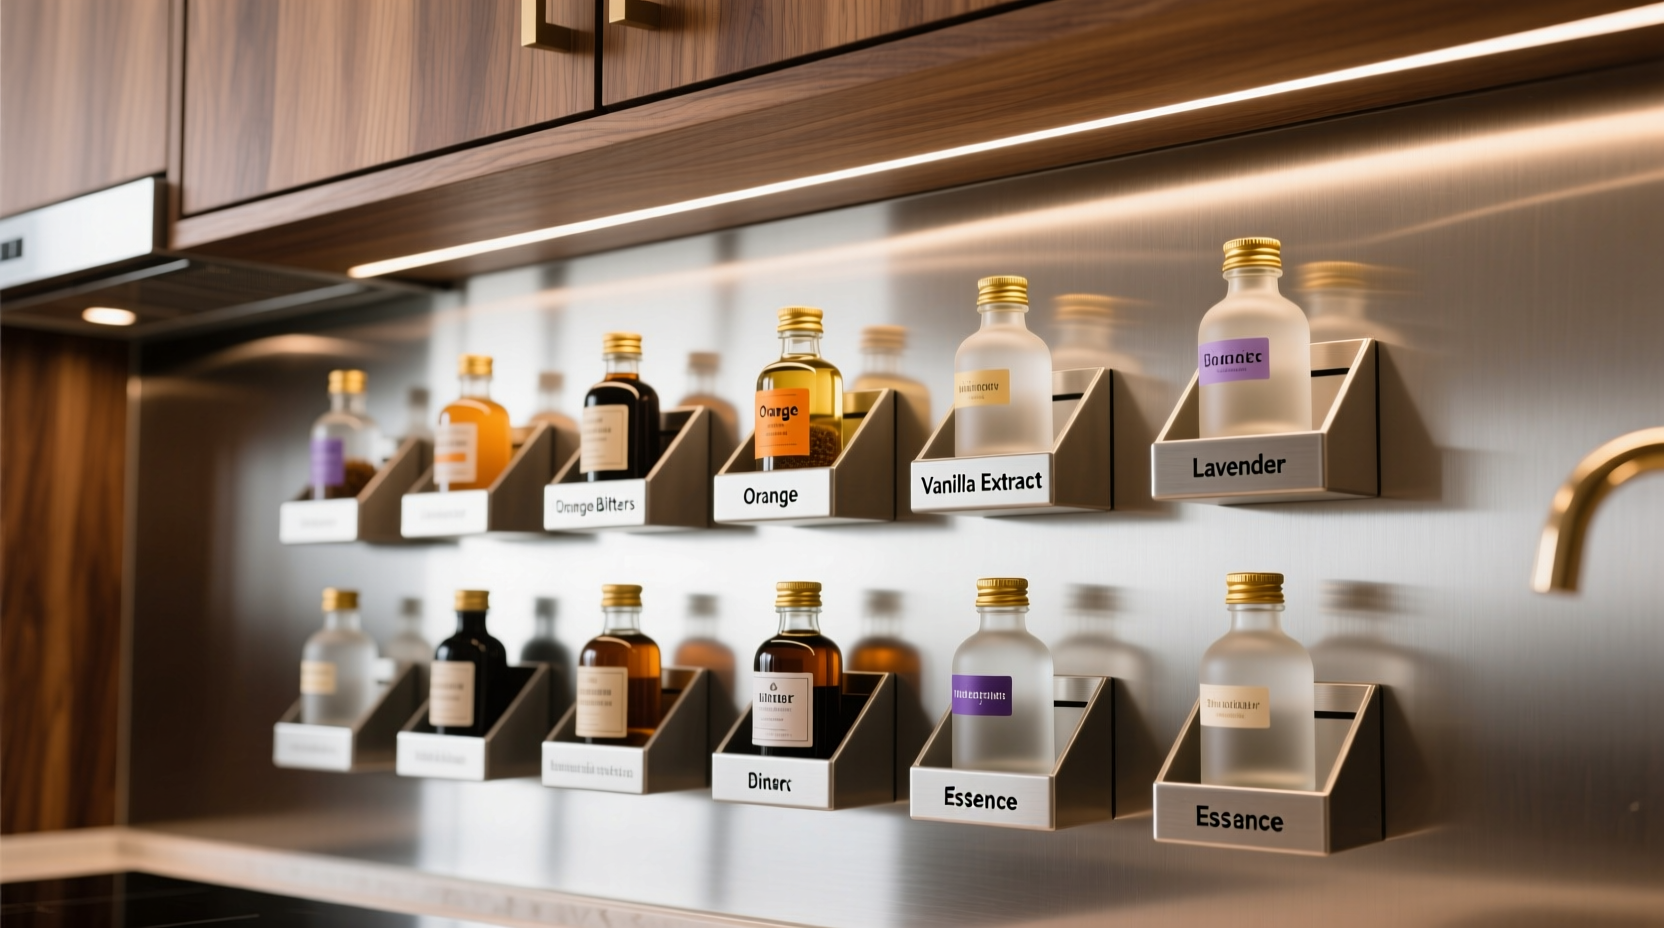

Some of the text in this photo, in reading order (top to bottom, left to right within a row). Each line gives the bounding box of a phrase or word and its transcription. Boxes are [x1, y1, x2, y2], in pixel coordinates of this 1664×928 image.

[1193, 453, 1287, 478] Lavender
[921, 472, 1043, 495] Vanilla Extract
[596, 496, 635, 512] Bitters
[743, 487, 799, 508] Orange
[944, 786, 1018, 811] Essence
[1196, 804, 1284, 832] Essance
